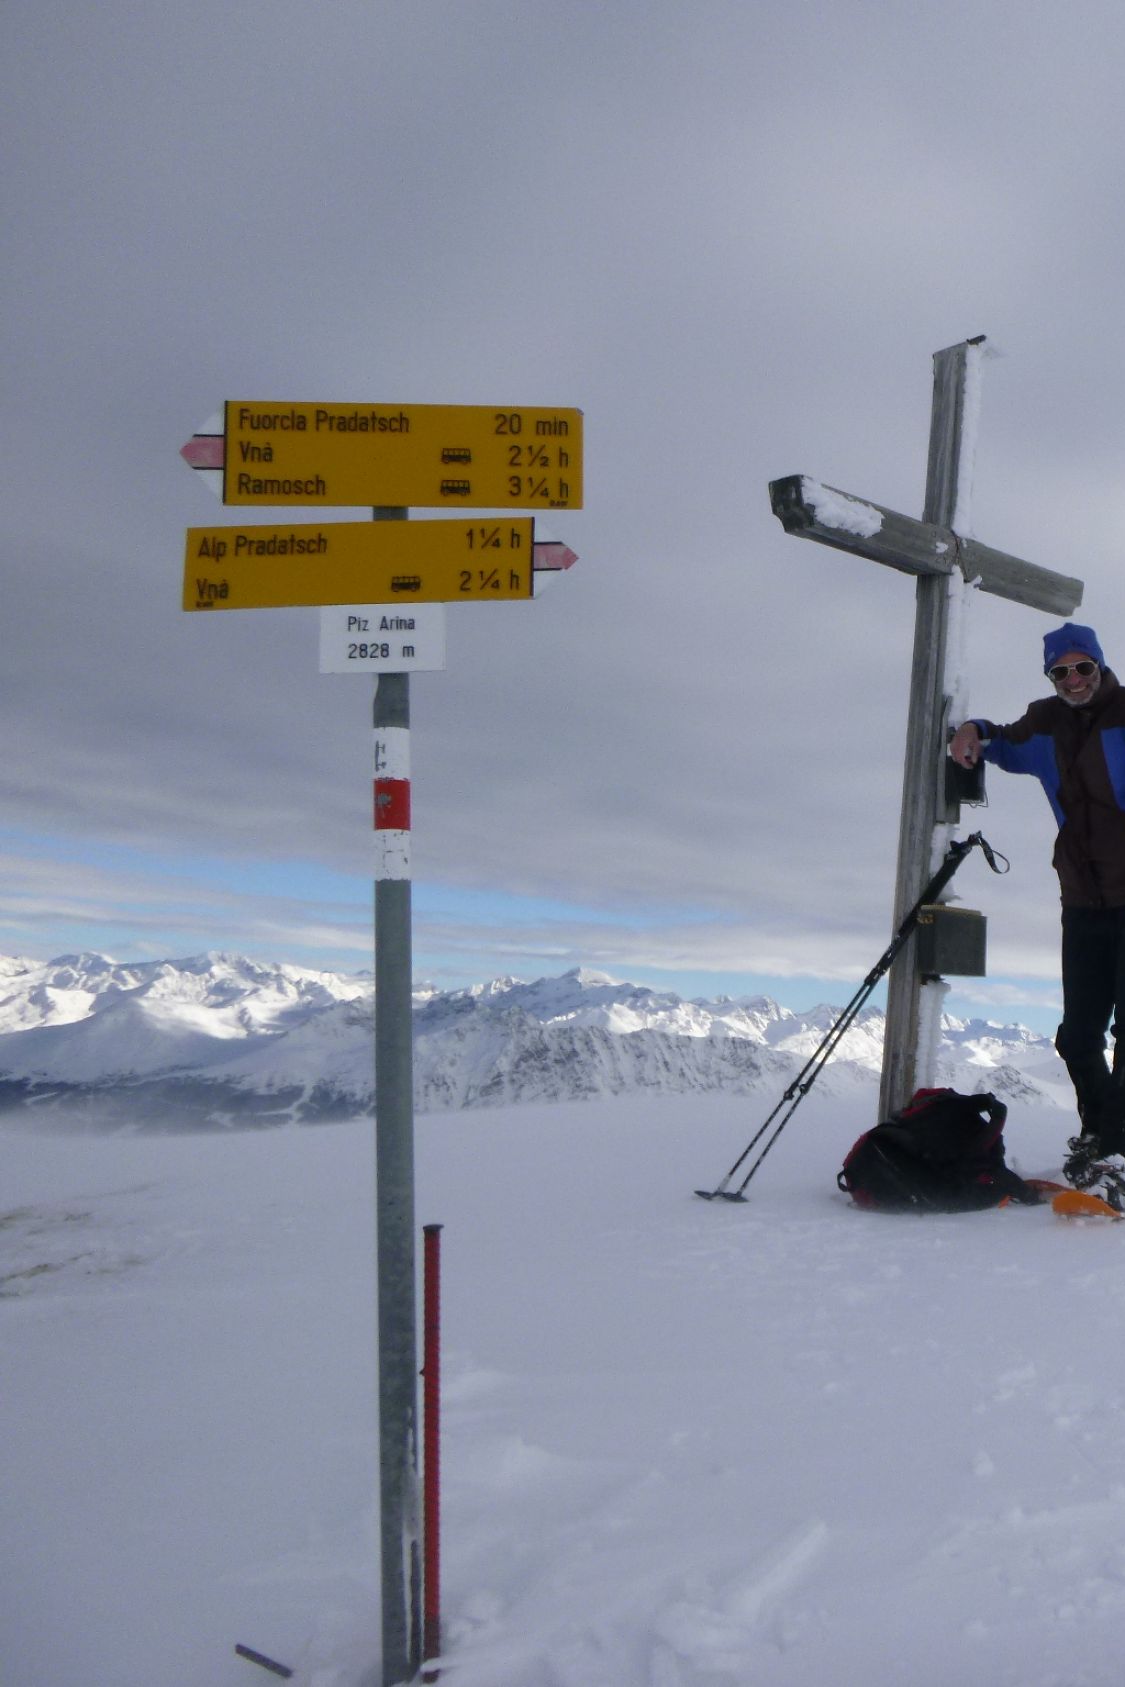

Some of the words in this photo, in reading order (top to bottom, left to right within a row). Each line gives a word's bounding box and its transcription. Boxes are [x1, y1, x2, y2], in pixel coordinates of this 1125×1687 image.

[238, 408, 307, 431] Fuorcla
[315, 409, 410, 433] Pradatsch
[494, 413, 522, 435] 20
[536, 416, 569, 436] min
[558, 446, 569, 467] h
[237, 472, 326, 496] Ramosch
[558, 477, 569, 498] h
[198, 536, 227, 562] Alp
[234, 532, 328, 557] Pradatsch
[510, 527, 520, 549] h
[509, 568, 519, 590] h
[347, 615, 369, 632] Piz
[379, 615, 416, 631] Arina
[347, 642, 390, 659] 2828
[402, 644, 415, 658] m
